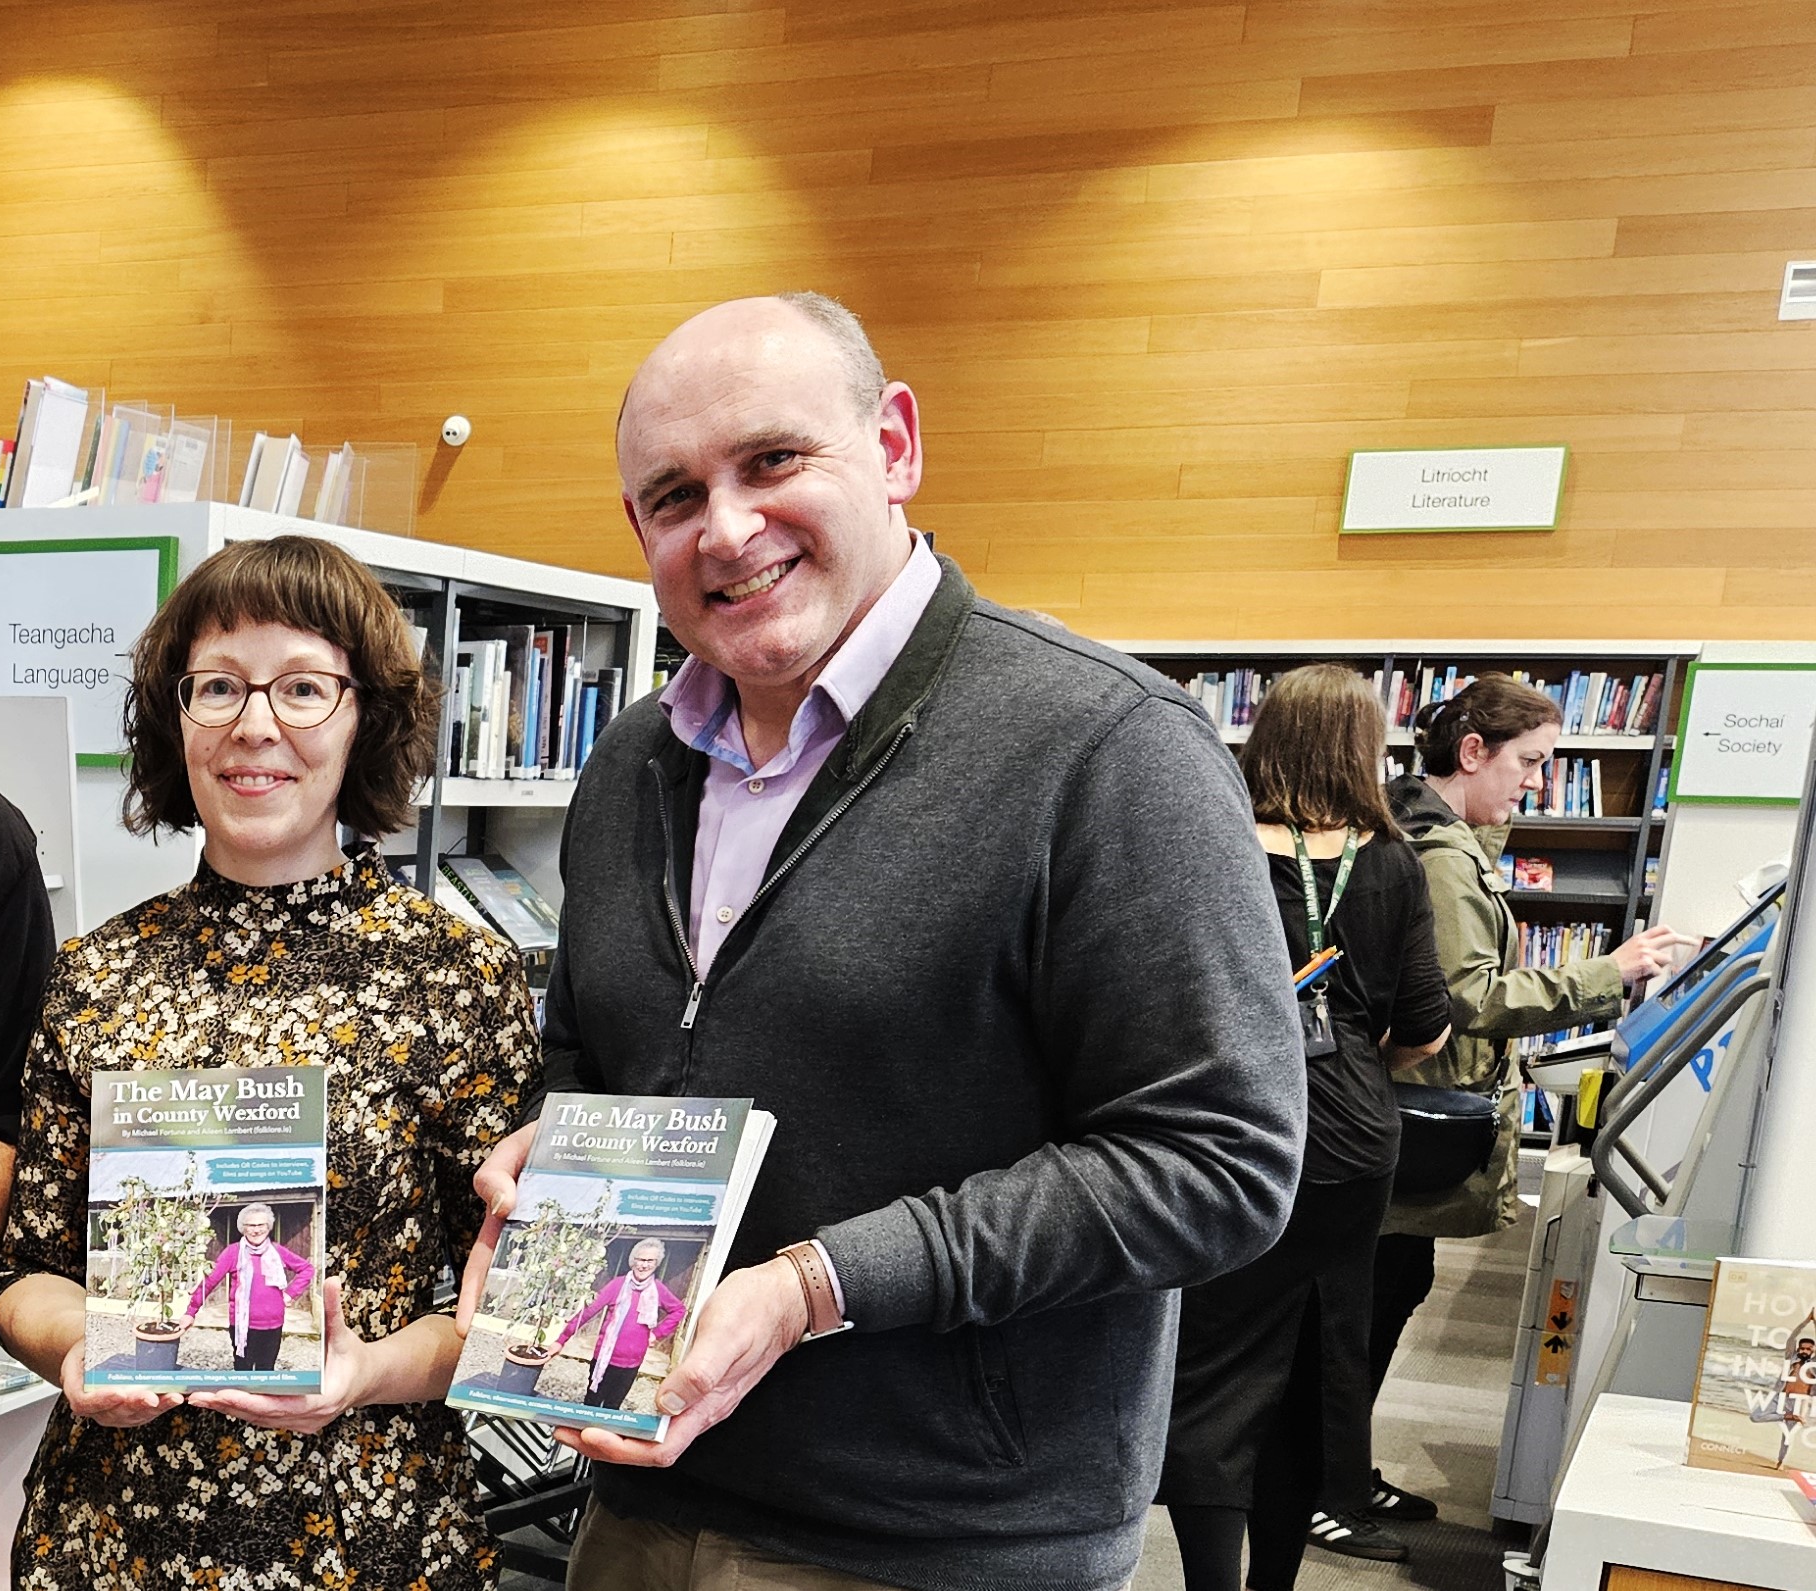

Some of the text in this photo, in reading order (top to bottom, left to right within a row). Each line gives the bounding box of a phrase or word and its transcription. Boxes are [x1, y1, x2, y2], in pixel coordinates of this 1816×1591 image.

[1412, 494, 1490, 508] Literature
[8, 622, 115, 649] Teangacha
[12, 662, 109, 689] Language
[1718, 738, 1782, 756] Society
[441, 865, 476, 903] BEASTLY
[1298, 854, 1319, 921] LIBRARY STAFF
[109, 1075, 304, 1104] The May Bush
[113, 1102, 300, 1126] in County Wexford
[557, 1104, 727, 1134] The May Bush
[160, 1128, 185, 1136] Fortune
[202, 1127, 223, 1135] Aileen
[254, 1126, 291, 1135] (folklore.ie)
[551, 1129, 719, 1154] in County Wexford
[1734, 1354, 1767, 1378] IN
[1700, 1442, 1746, 1455] CONNECT
